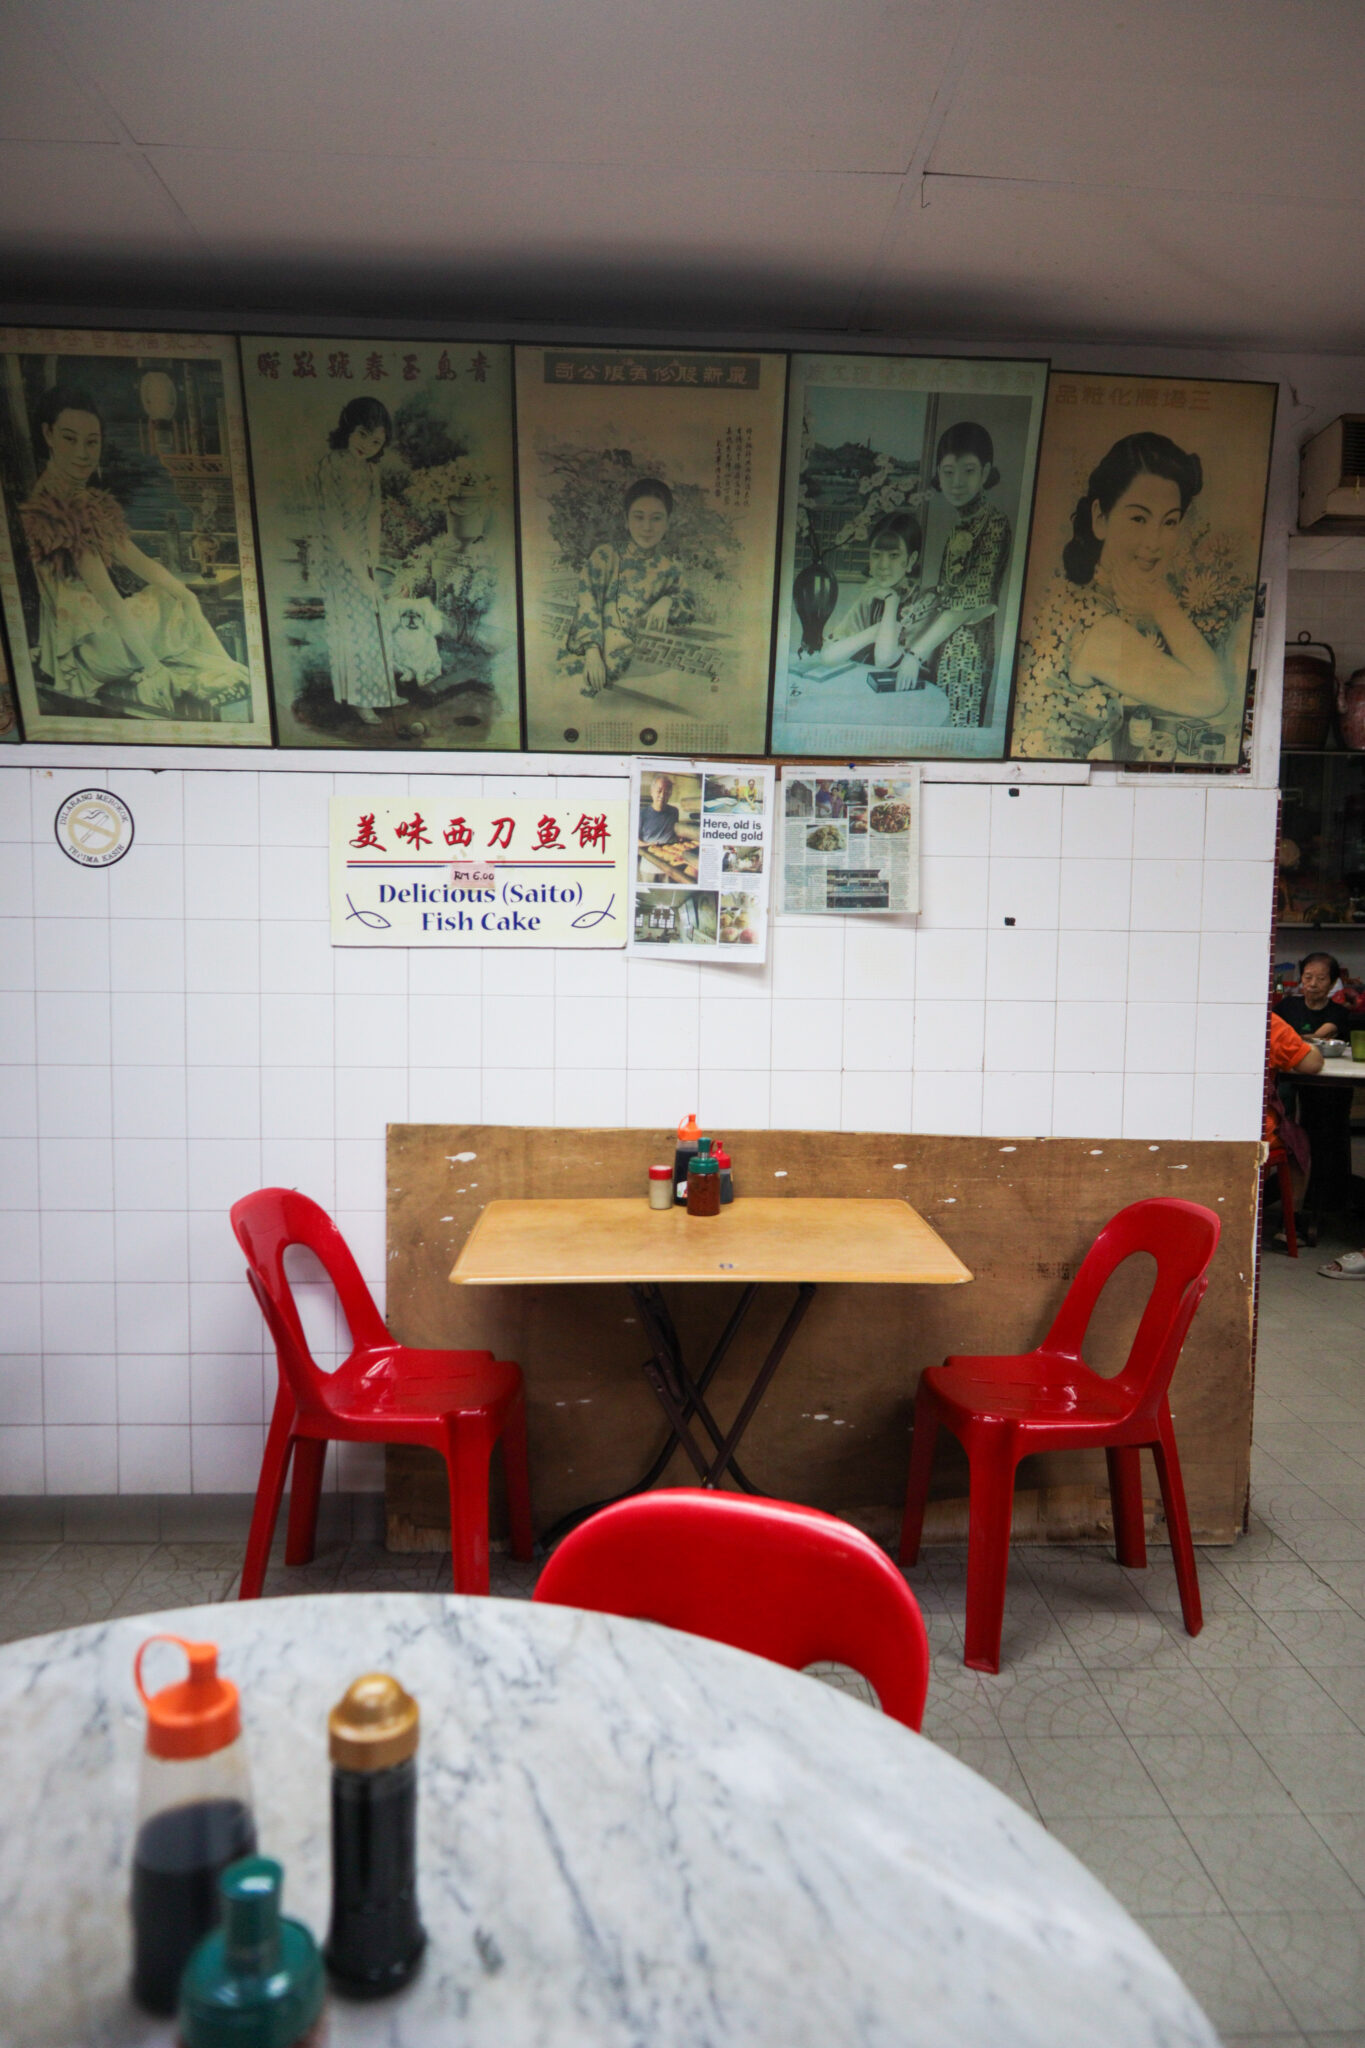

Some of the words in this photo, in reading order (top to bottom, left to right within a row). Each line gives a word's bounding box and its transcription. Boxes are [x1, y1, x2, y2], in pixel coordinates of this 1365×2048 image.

[60, 793, 93, 825] DILARANG
[349, 812, 612, 854] 美味西刀魚餅
[702, 818, 731, 830] Here,
[733, 819, 750, 830] old
[752, 820, 762, 830] is
[702, 830, 738, 840] indeed
[740, 831, 764, 842] gold
[378, 883, 496, 904] Delicious
[502, 882, 583, 906] (Saito)
[421, 910, 473, 931] Fish
[480, 911, 542, 931] Cake
